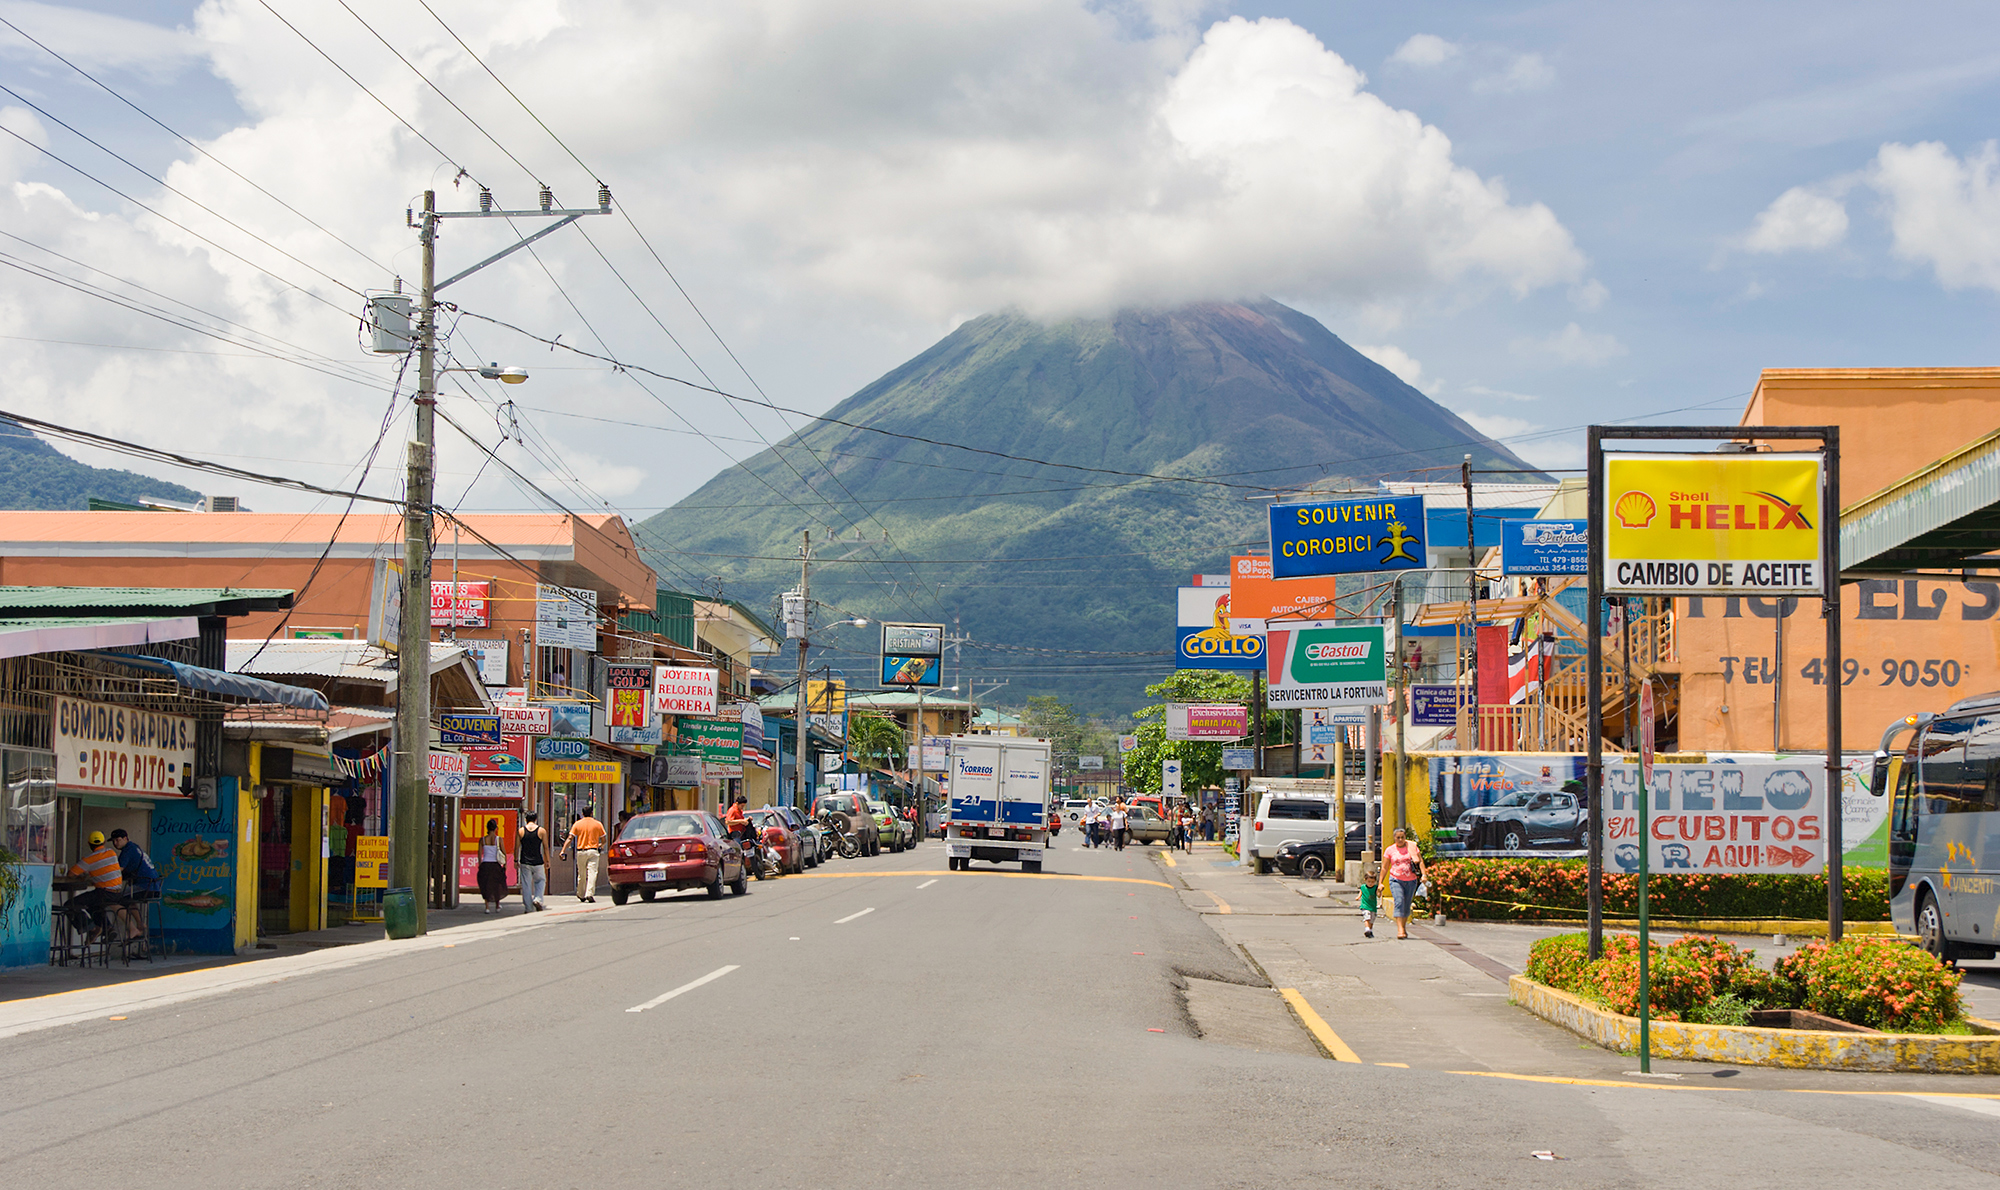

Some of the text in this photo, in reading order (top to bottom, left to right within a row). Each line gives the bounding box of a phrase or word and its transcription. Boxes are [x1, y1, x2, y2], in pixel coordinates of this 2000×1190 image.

[1669, 491, 1709, 502] Shell
[1296, 503, 1397, 526] SOUVENIR
[1669, 500, 1811, 530] HELIX
[1282, 534, 1372, 558] COROBICI
[1617, 562, 1813, 587] CAMBIO DE ACEITE
[1295, 596, 1327, 604] CAJERO
[888, 632, 933, 648] CRISTIAN 2
[1185, 637, 1261, 655] GOLLO
[1321, 644, 1364, 658] Castrol
[609, 668, 650, 677] LOCAL OF
[662, 669, 711, 682] JOYERIA
[613, 676, 645, 688] GOLD
[658, 684, 713, 697] RELOJERIA
[1269, 685, 1384, 702] SERVICENTRO LA FORTUNA
[560, 705, 590, 715] COMERCIAL
[658, 697, 712, 713] MORERA
[501, 710, 534, 721] TIENDA
[538, 711, 546, 720] Y
[1191, 708, 1245, 717] Exclusividades
[60, 699, 125, 744] COMIDAS
[442, 717, 498, 732] SOUVENIR
[528, 723, 547, 733] CECI
[682, 722, 702, 730] Tienda
[1191, 719, 1237, 727] MARIA PAZ
[443, 734, 452, 742] EL
[697, 735, 740, 749] Fortuna
[91, 748, 166, 791] PITO PITO
[552, 763, 577, 771] JOYERIA
[964, 765, 993, 774] CORREOS
[1442, 762, 1491, 775] Sueña
[560, 772, 613, 781] SE COMPRA ORO
[491, 780, 520, 788] FORTUNA
[1470, 778, 1514, 791] Vívelo
[1608, 769, 1813, 811] HIELO
[961, 794, 981, 805] 21
[460, 814, 505, 838] NIR
[1650, 814, 1821, 842] CUBITOS
[358, 838, 377, 847] BEAUTY
[18, 900, 47, 935] FOOD
